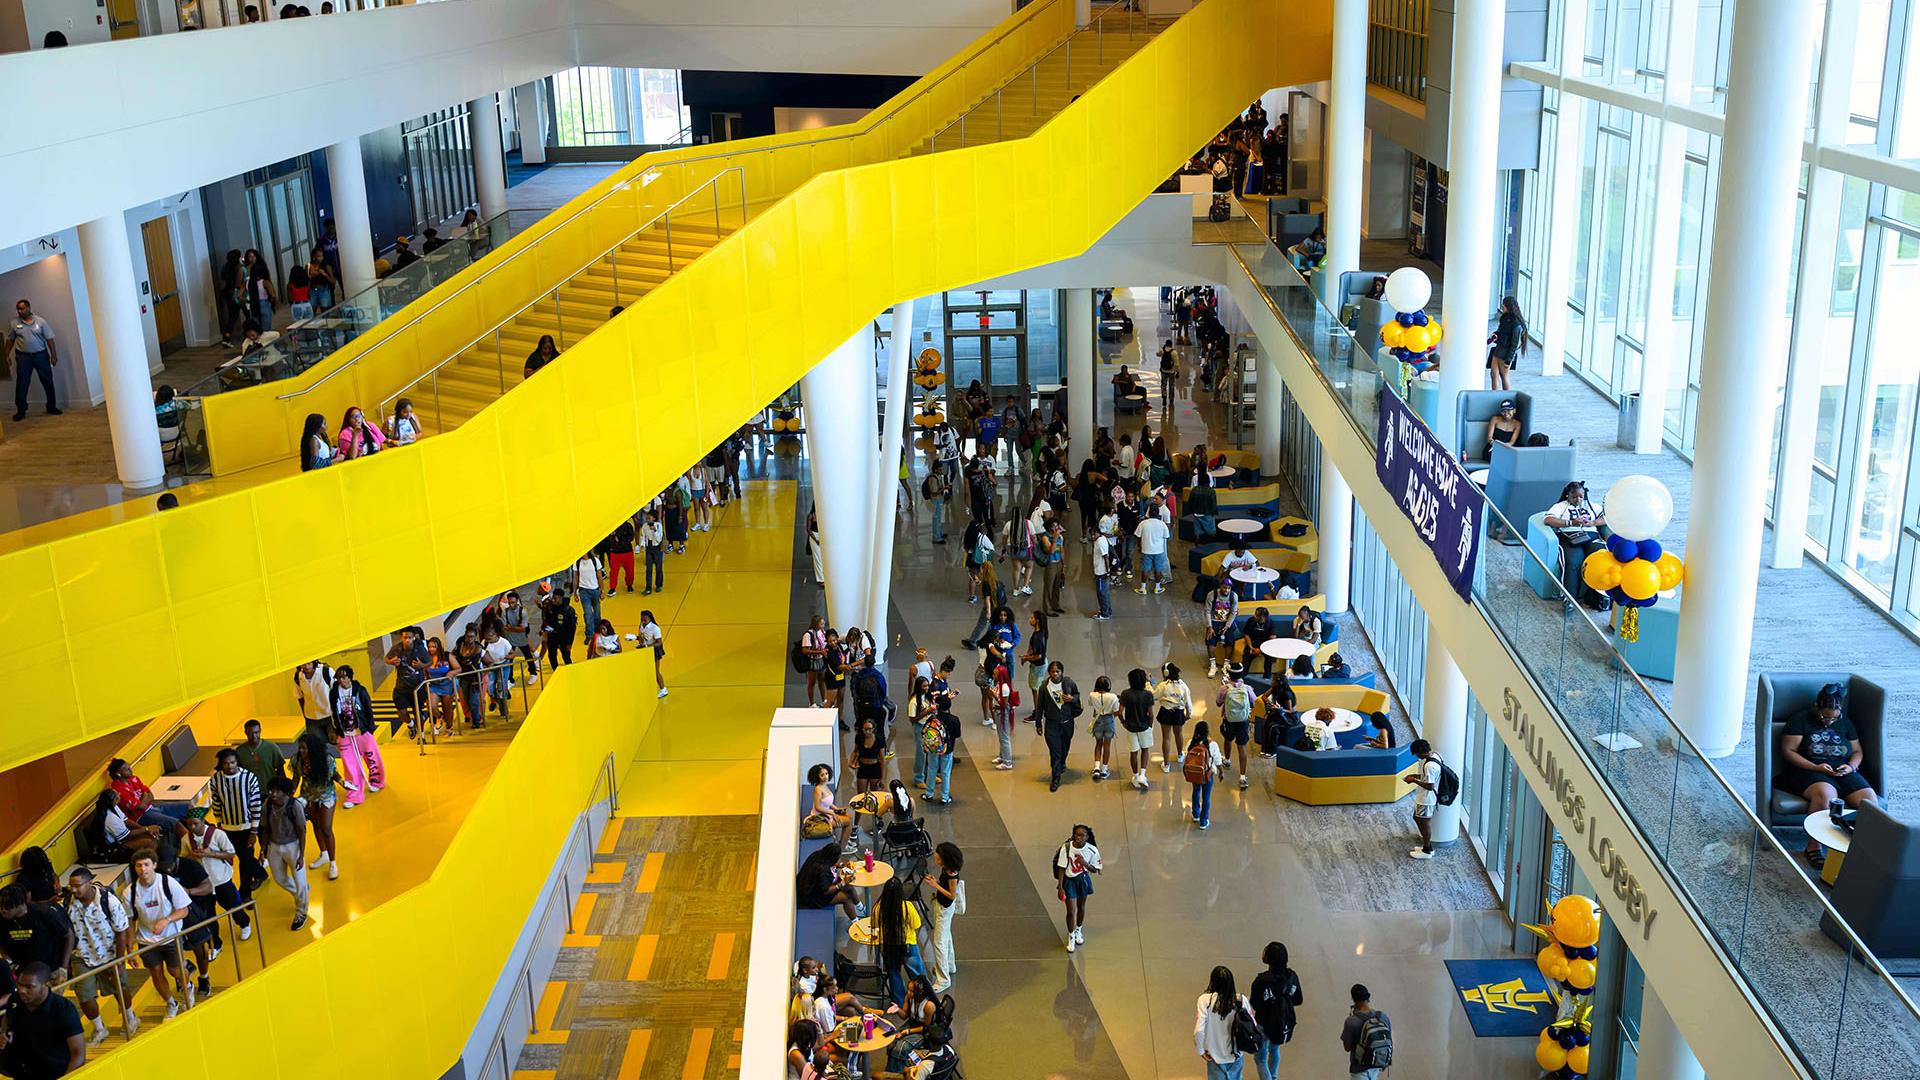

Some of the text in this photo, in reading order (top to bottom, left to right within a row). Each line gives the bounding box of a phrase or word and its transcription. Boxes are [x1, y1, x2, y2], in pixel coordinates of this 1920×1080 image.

[1398, 409, 1459, 510] WELCOME HOME
[1502, 686, 1658, 941] STALLINGS LOBBY
